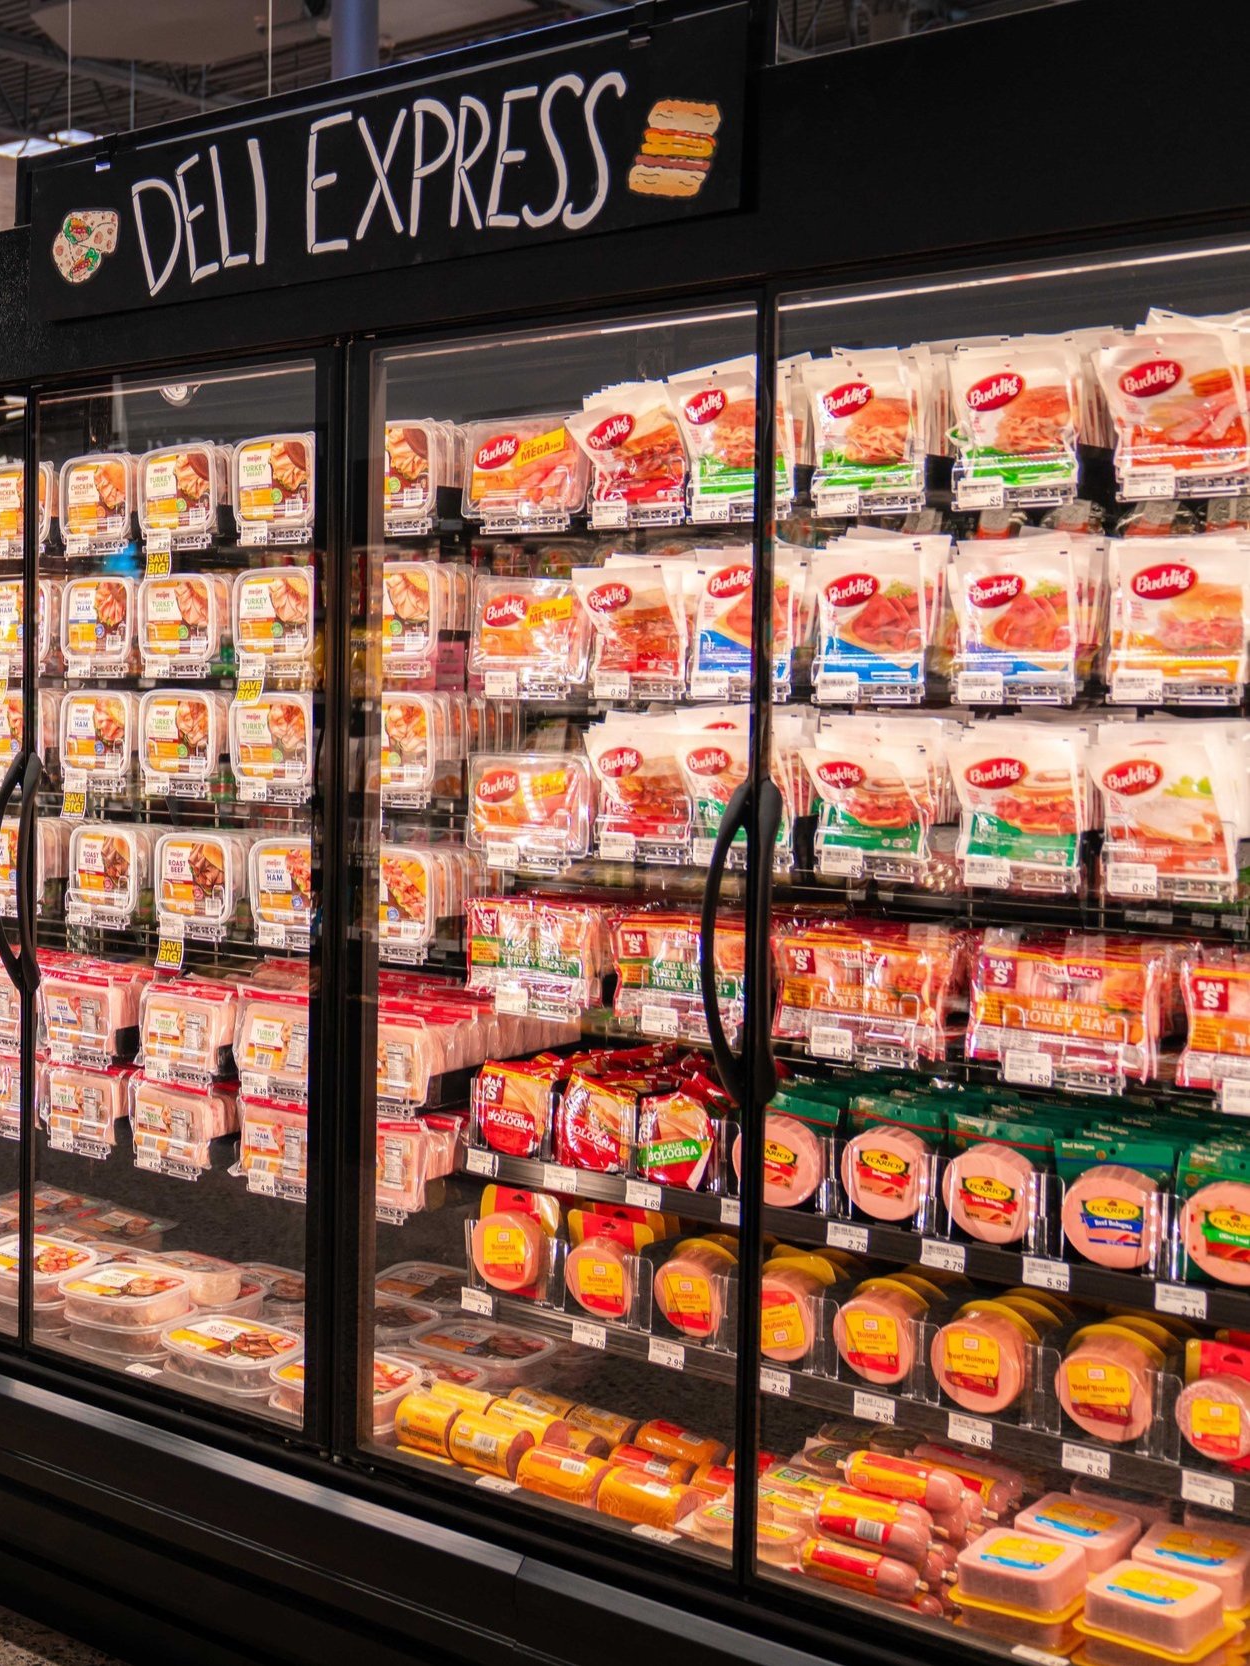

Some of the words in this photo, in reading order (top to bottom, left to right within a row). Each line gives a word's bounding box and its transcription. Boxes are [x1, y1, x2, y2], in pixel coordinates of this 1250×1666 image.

[131, 138, 267, 296] DELI
[306, 71, 627, 253] EXPRESS
[1123, 363, 1177, 393] Buddig
[969, 376, 1019, 408] Buddig
[824, 385, 873, 413] Buddig
[686, 392, 724, 421] Buddig
[589, 416, 631, 448] Buddig
[478, 437, 516, 465] Buddig
[521, 442, 551, 462] MEGA
[154, 466, 168, 474] meijer
[243, 463, 267, 472] TURKEY
[150, 475, 171, 484] TURKEY
[71, 483, 94, 491] CHICKEN
[710, 510, 728, 519] 0.89
[253, 535, 267, 544] 2.99
[148, 553, 169, 563] SAVE
[147, 562, 169, 574] BIG!
[710, 570, 751, 593] Buddig
[1136, 568, 1191, 593] Buddig
[827, 578, 873, 602] Buddig
[971, 577, 1019, 602] Buddig
[244, 597, 268, 605] TURKEY
[589, 587, 627, 609] Buddig
[76, 604, 91, 612] HAM
[486, 599, 526, 621] Buddig
[529, 607, 557, 625] MEGA
[239, 680, 262, 690] SAVE
[237, 690, 259, 701] BIG!
[610, 688, 628, 697] 0.89
[980, 690, 1002, 700] 0.89
[155, 709, 170, 717] meijer
[246, 713, 261, 721] meijer
[74, 721, 89, 729] HAM
[151, 718, 174, 726] TURKEY
[242, 722, 266, 730] TURKEY
[600, 750, 637, 772] Buddig
[688, 751, 726, 771] Buddig
[818, 765, 861, 783] Buddig
[969, 762, 1021, 784] Buddig
[1107, 764, 1158, 790] Buddig
[156, 785, 169, 794] 2.99
[479, 774, 516, 796] Buddig
[65, 792, 85, 802] SAVE
[252, 791, 266, 799] 2.99
[64, 801, 85, 813] BIG!
[170, 850, 184, 858] meijer
[84, 857, 97, 865] BEEF
[168, 859, 186, 867] ROAST
[266, 859, 282, 868] meijer
[266, 873, 283, 881] HAM
[1131, 883, 1156, 894] 0.89
[270, 937, 284, 945] 2.99
[623, 933, 644, 941] BAR
[160, 940, 182, 952] SAVE
[628, 940, 642, 954] S
[158, 951, 181, 962] BIG!
[789, 949, 811, 958] BAR
[830, 950, 858, 961] FRESH
[662, 960, 681, 970] DELI
[795, 956, 809, 971] S
[989, 959, 1014, 970] BAR
[1035, 963, 1067, 977] FRESH
[1068, 966, 1101, 979] PACK
[652, 977, 690, 988] TURKEY
[993, 969, 1009, 985] S
[1197, 980, 1225, 993] BAR
[1202, 991, 1219, 1009] S
[56, 1004, 68, 1012] HAM
[872, 1002, 904, 1015] HAM
[1031, 1000, 1055, 1012] DELI
[1056, 1002, 1100, 1018] SHAVED
[155, 1018, 176, 1026] TURKEY
[1019, 1009, 1074, 1028] HONEY
[1081, 1015, 1117, 1034] HAM
[256, 1029, 279, 1037] TURKEY
[660, 1024, 677, 1033] 1.59
[832, 1047, 851, 1058] 1.59
[1029, 1073, 1050, 1084] 1.59
[253, 1087, 267, 1096] 8.49
[485, 1086, 497, 1100] S
[499, 1108, 525, 1120] CLASSIC
[487, 1110, 535, 1131] BOLOGNA
[254, 1131, 270, 1141] HAM
[61, 1141, 74, 1150] 4.99
[658, 1141, 684, 1151] GARLIC
[1062, 1141, 1072, 1149] Beef
[1071, 1142, 1095, 1151] Bologna
[647, 1145, 699, 1161] BOLOGNA
[865, 1155, 902, 1170] ECKRICH
[872, 1169, 892, 1180] Bologna
[260, 1184, 275, 1193] 4.99
[969, 1182, 1008, 1197] ECKRICH
[644, 1198, 660, 1208] 1.69
[971, 1195, 985, 1203] Thick
[985, 1198, 1005, 1209] Bologna
[1091, 1205, 1136, 1216] ECKRICH
[1094, 1219, 1108, 1227] Beef
[1108, 1220, 1133, 1231] Bologna
[1219, 1232, 1233, 1242] Olive
[1234, 1235, 1249, 1246] Loaf
[491, 1243, 516, 1252] Bologna
[848, 1239, 867, 1251] 2.79
[943, 1259, 964, 1271] 2.79
[587, 1275, 614, 1284] Bologna
[1046, 1277, 1068, 1289] 5.99
[674, 1292, 701, 1301] Bologna
[477, 1304, 492, 1315] 2.79
[1181, 1305, 1205, 1318] 2.19
[763, 1319, 794, 1331] Bologna
[856, 1331, 887, 1341] Bologna
[589, 1337, 605, 1349] 2.79
[666, 1356, 684, 1369] 2.99
[947, 1351, 965, 1361] Beef
[965, 1354, 995, 1365] Bologna
[771, 1383, 790, 1395] 2.99
[1071, 1383, 1090, 1392] Beef
[1091, 1384, 1125, 1394] Bologna
[875, 1411, 895, 1424] 2.99
[970, 1434, 992, 1448] 8.59
[1086, 1463, 1109, 1478] 8.59
[1209, 1494, 1233, 1509] 7.69
